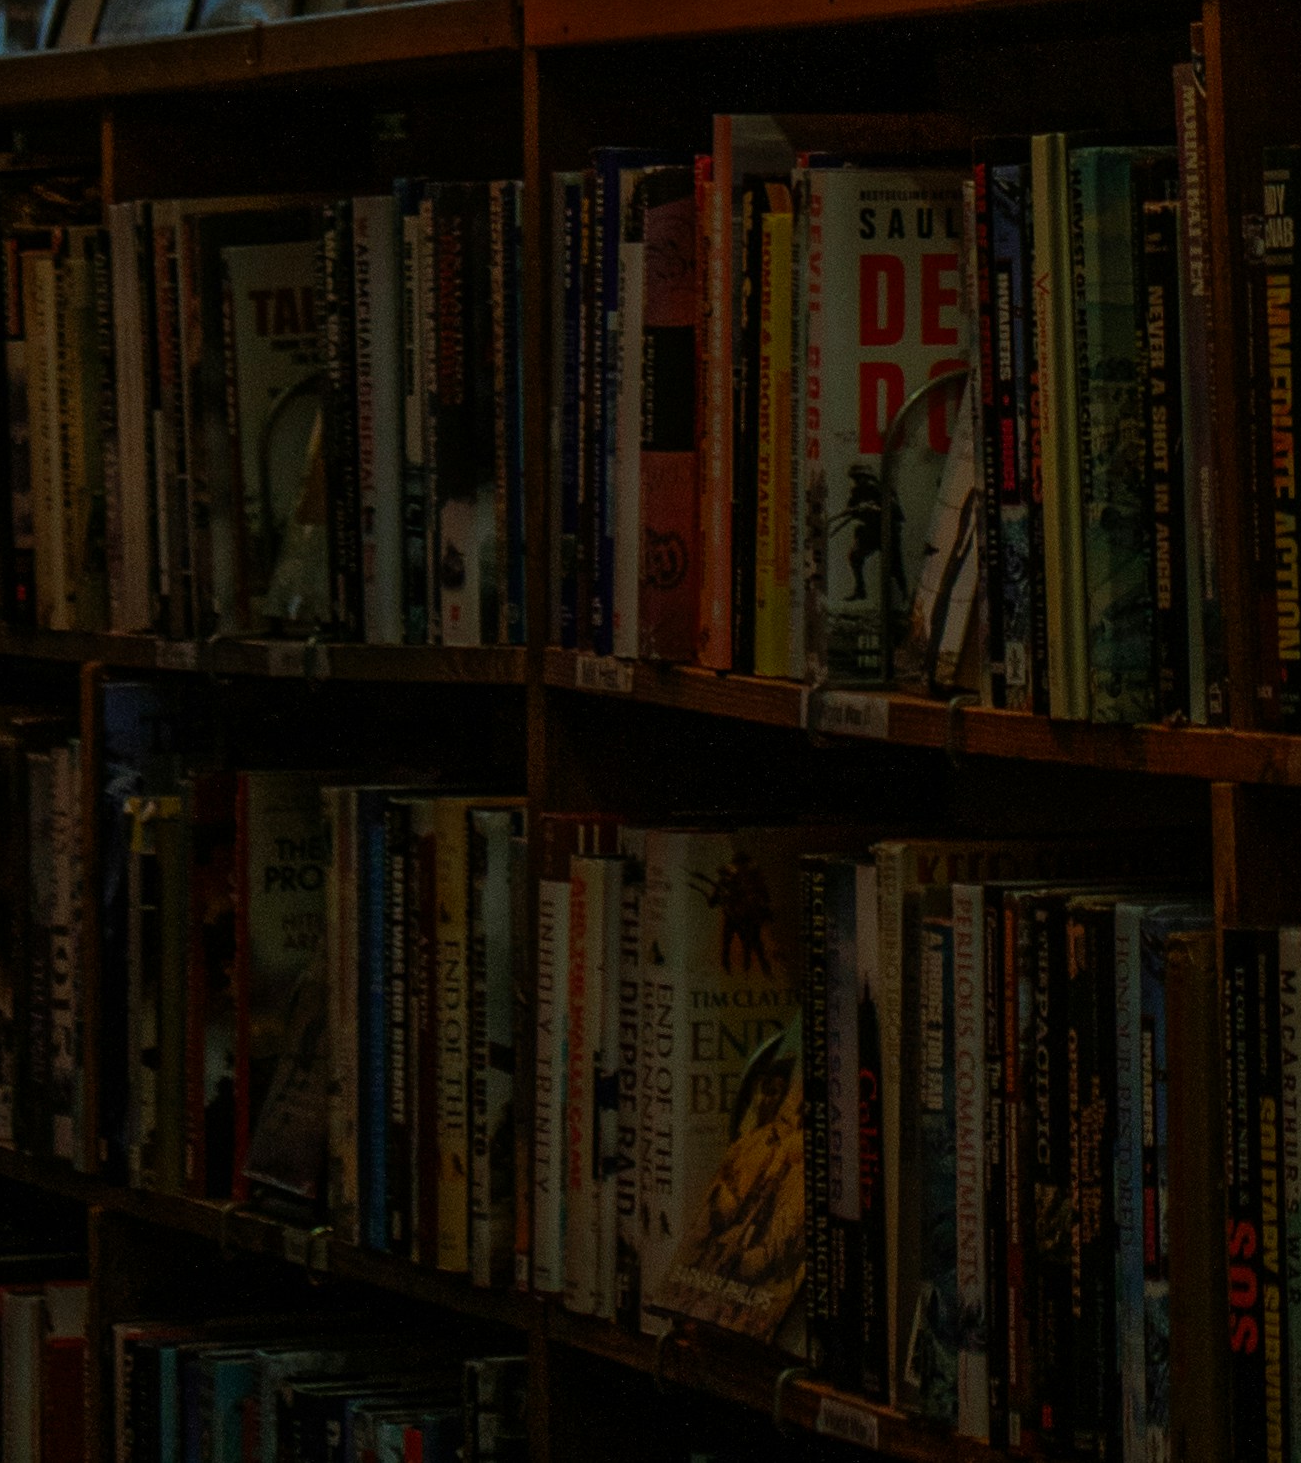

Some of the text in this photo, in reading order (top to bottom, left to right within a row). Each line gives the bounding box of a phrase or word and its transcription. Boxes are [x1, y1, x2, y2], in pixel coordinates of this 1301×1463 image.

[859, 206, 960, 241] SAUL
[1181, 84, 1208, 298] MOUNTBATTEN
[1145, 284, 1174, 611] NEVER A SHOT IN ANGER
[1266, 274, 1297, 500] IMMEDIATE
[1274, 511, 1301, 661] ACTION
[535, 898, 555, 1194] UNHOLY TRINITY
[615, 894, 640, 1217] THE DIEPPE RAID
[655, 982, 675, 1196] END OF THE
[810, 871, 830, 1320] SECRET GERMANY MICHAEL BAIGENT
[858, 1066, 880, 1210] Colditz
[953, 898, 980, 1288] PERILOUS COMMITMENTS
[1279, 969, 1301, 1306] MACARTHUR'S WAR
[1227, 1216, 1259, 1356] SOS
